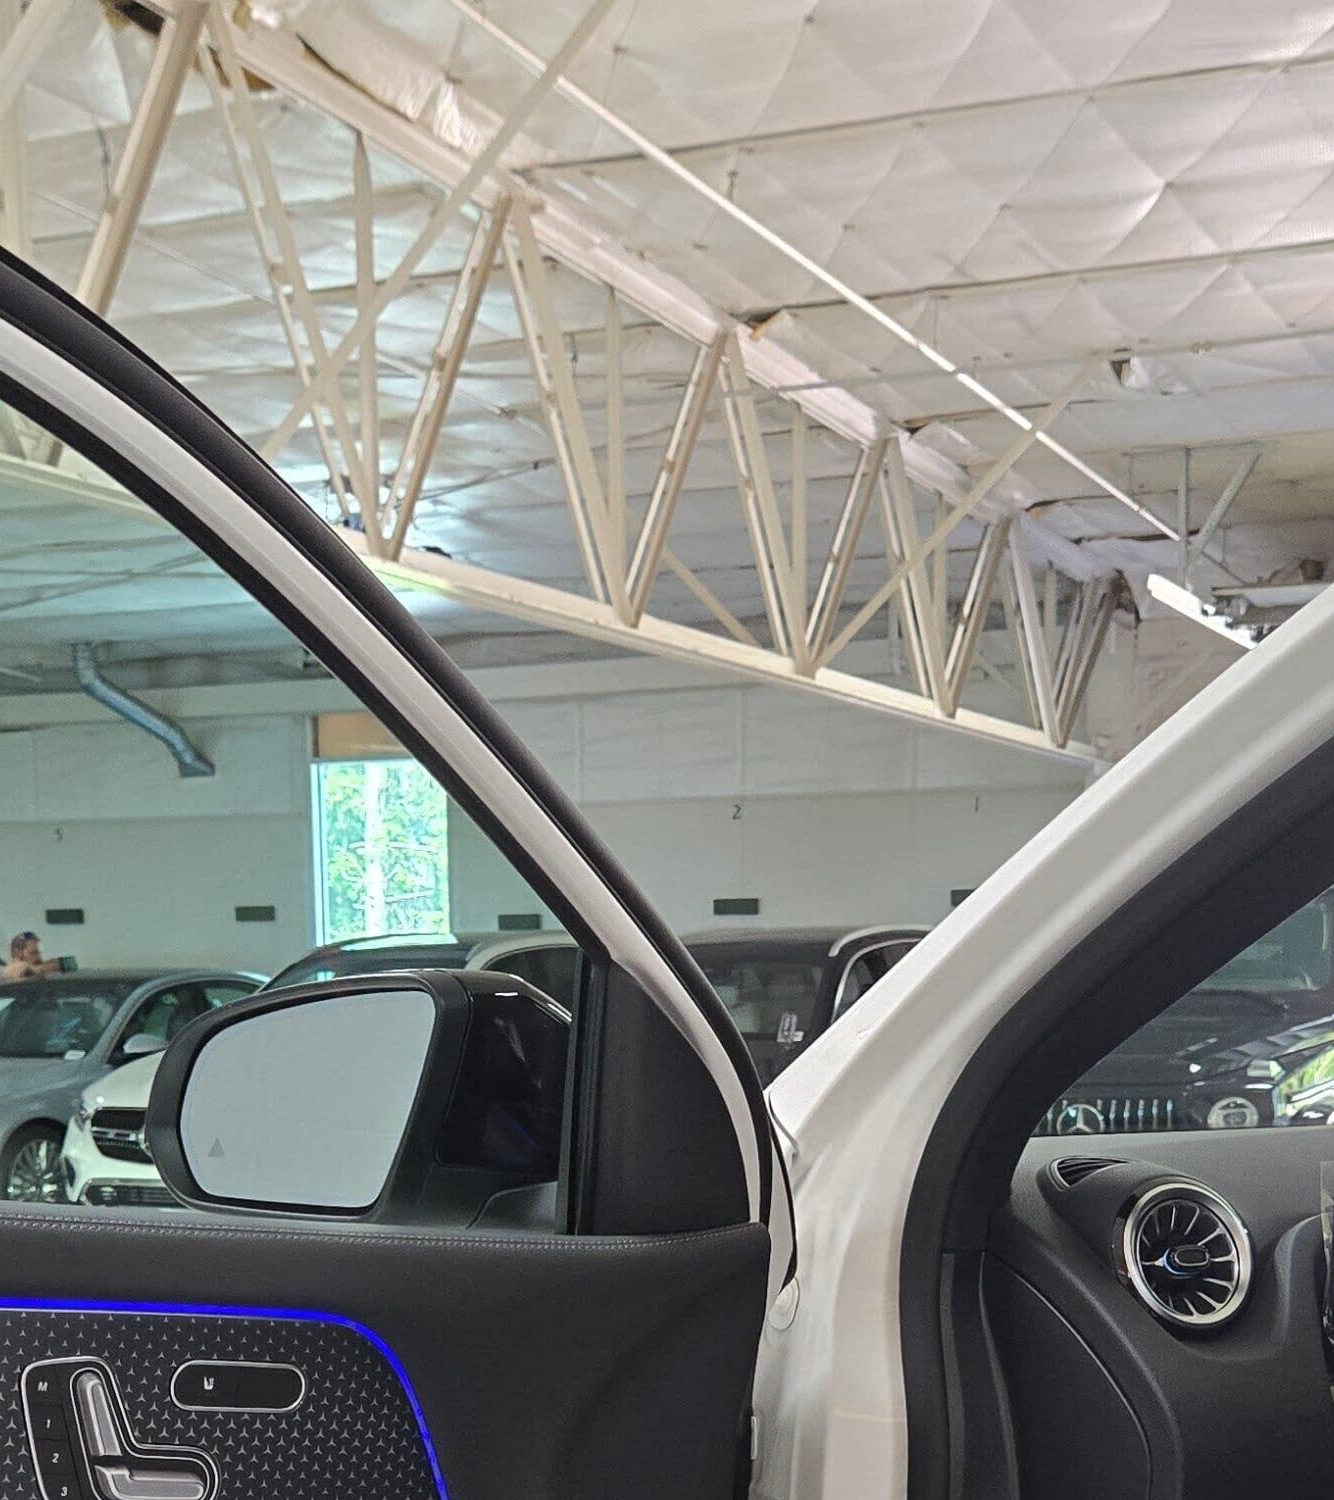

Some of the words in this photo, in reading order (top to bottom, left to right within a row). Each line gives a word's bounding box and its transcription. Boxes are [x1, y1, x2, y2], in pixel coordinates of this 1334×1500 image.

[37, 1381, 48, 1392] M
[51, 1452, 60, 1463] 2
[60, 1486, 68, 1497] 3
